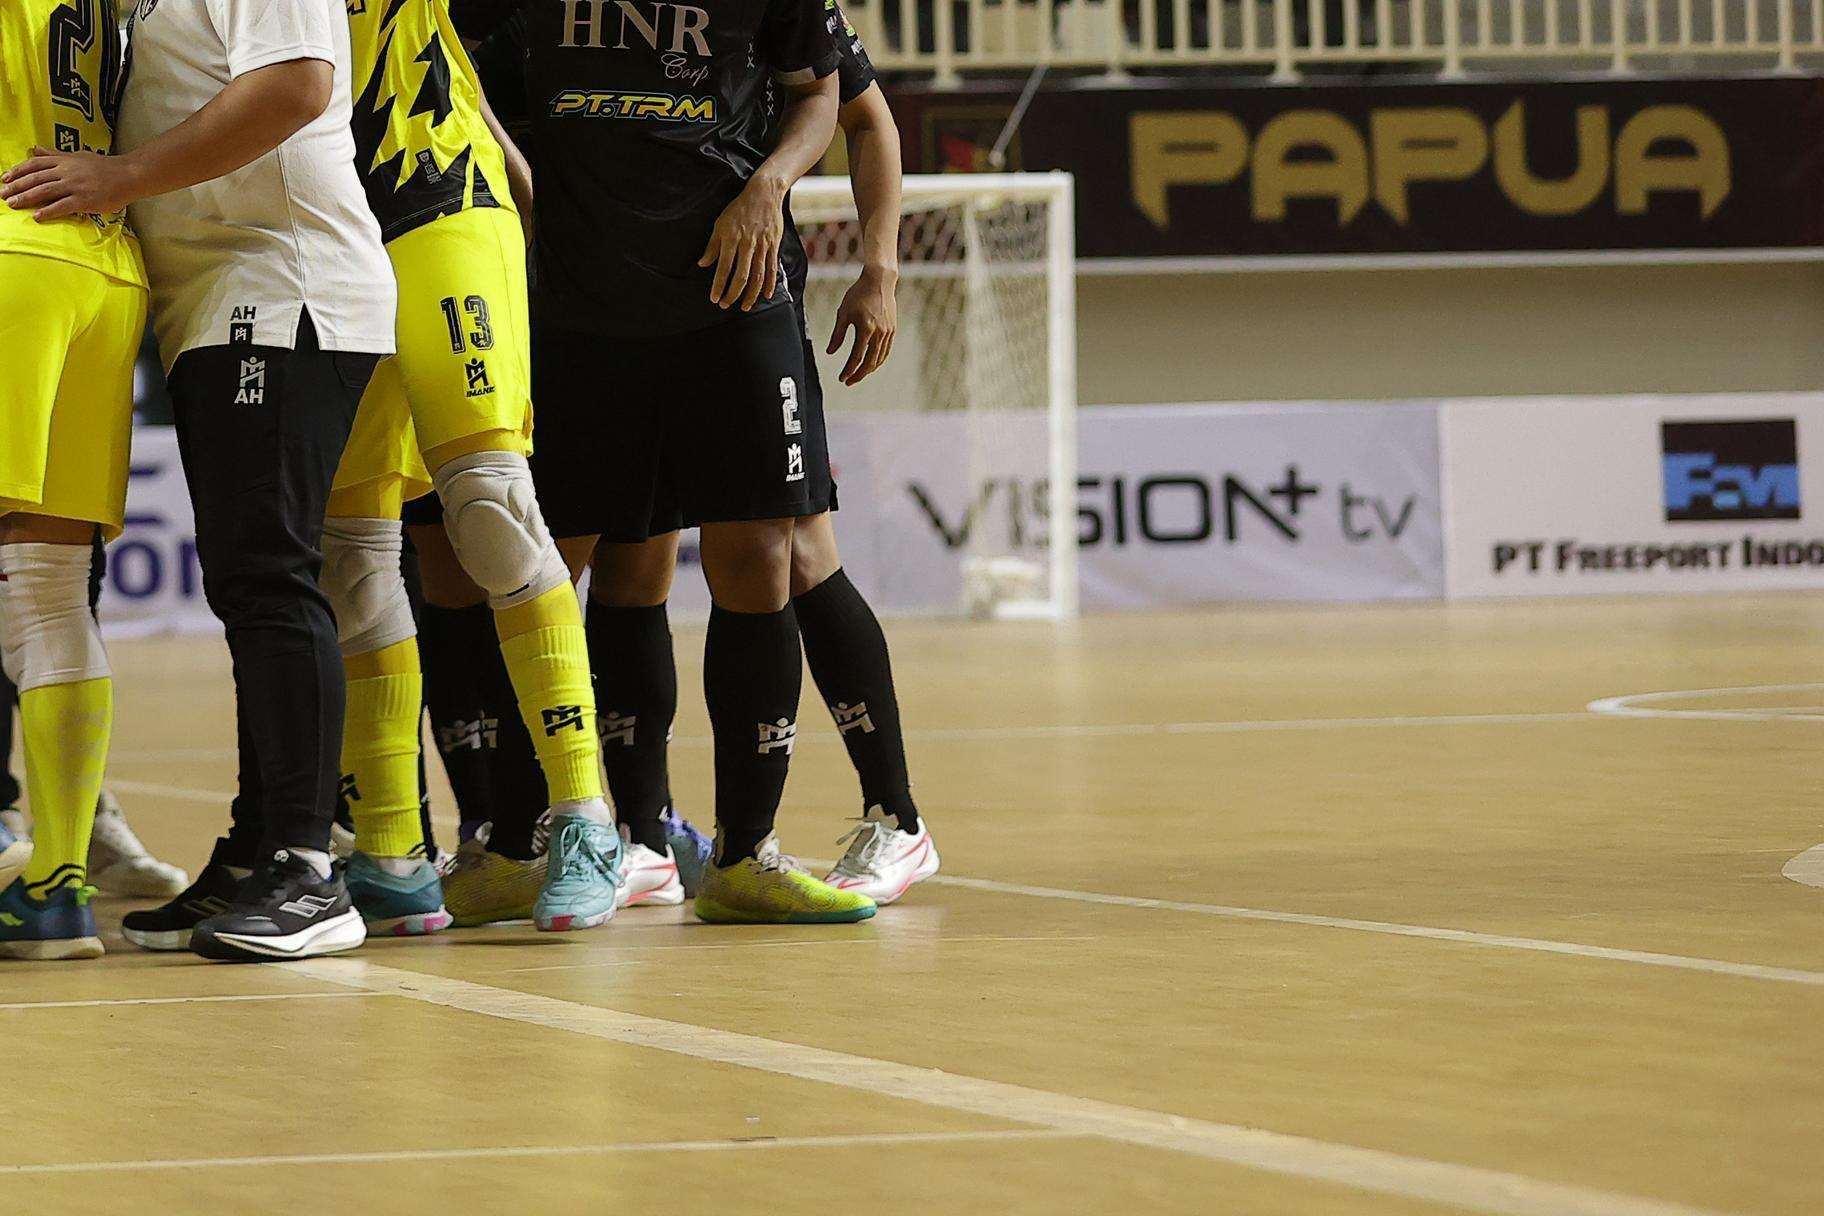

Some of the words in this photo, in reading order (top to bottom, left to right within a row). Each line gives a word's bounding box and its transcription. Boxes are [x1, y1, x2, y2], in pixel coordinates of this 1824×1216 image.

[660, 53, 710, 87] Corp
[1128, 96, 1732, 230] PAPUA
[230, 306, 257, 321] AH
[440, 294, 495, 355] 13
[234, 388, 264, 405] AH
[780, 376, 803, 435] 2
[1336, 482, 1415, 546] tv
[1492, 539, 1544, 575] PT
